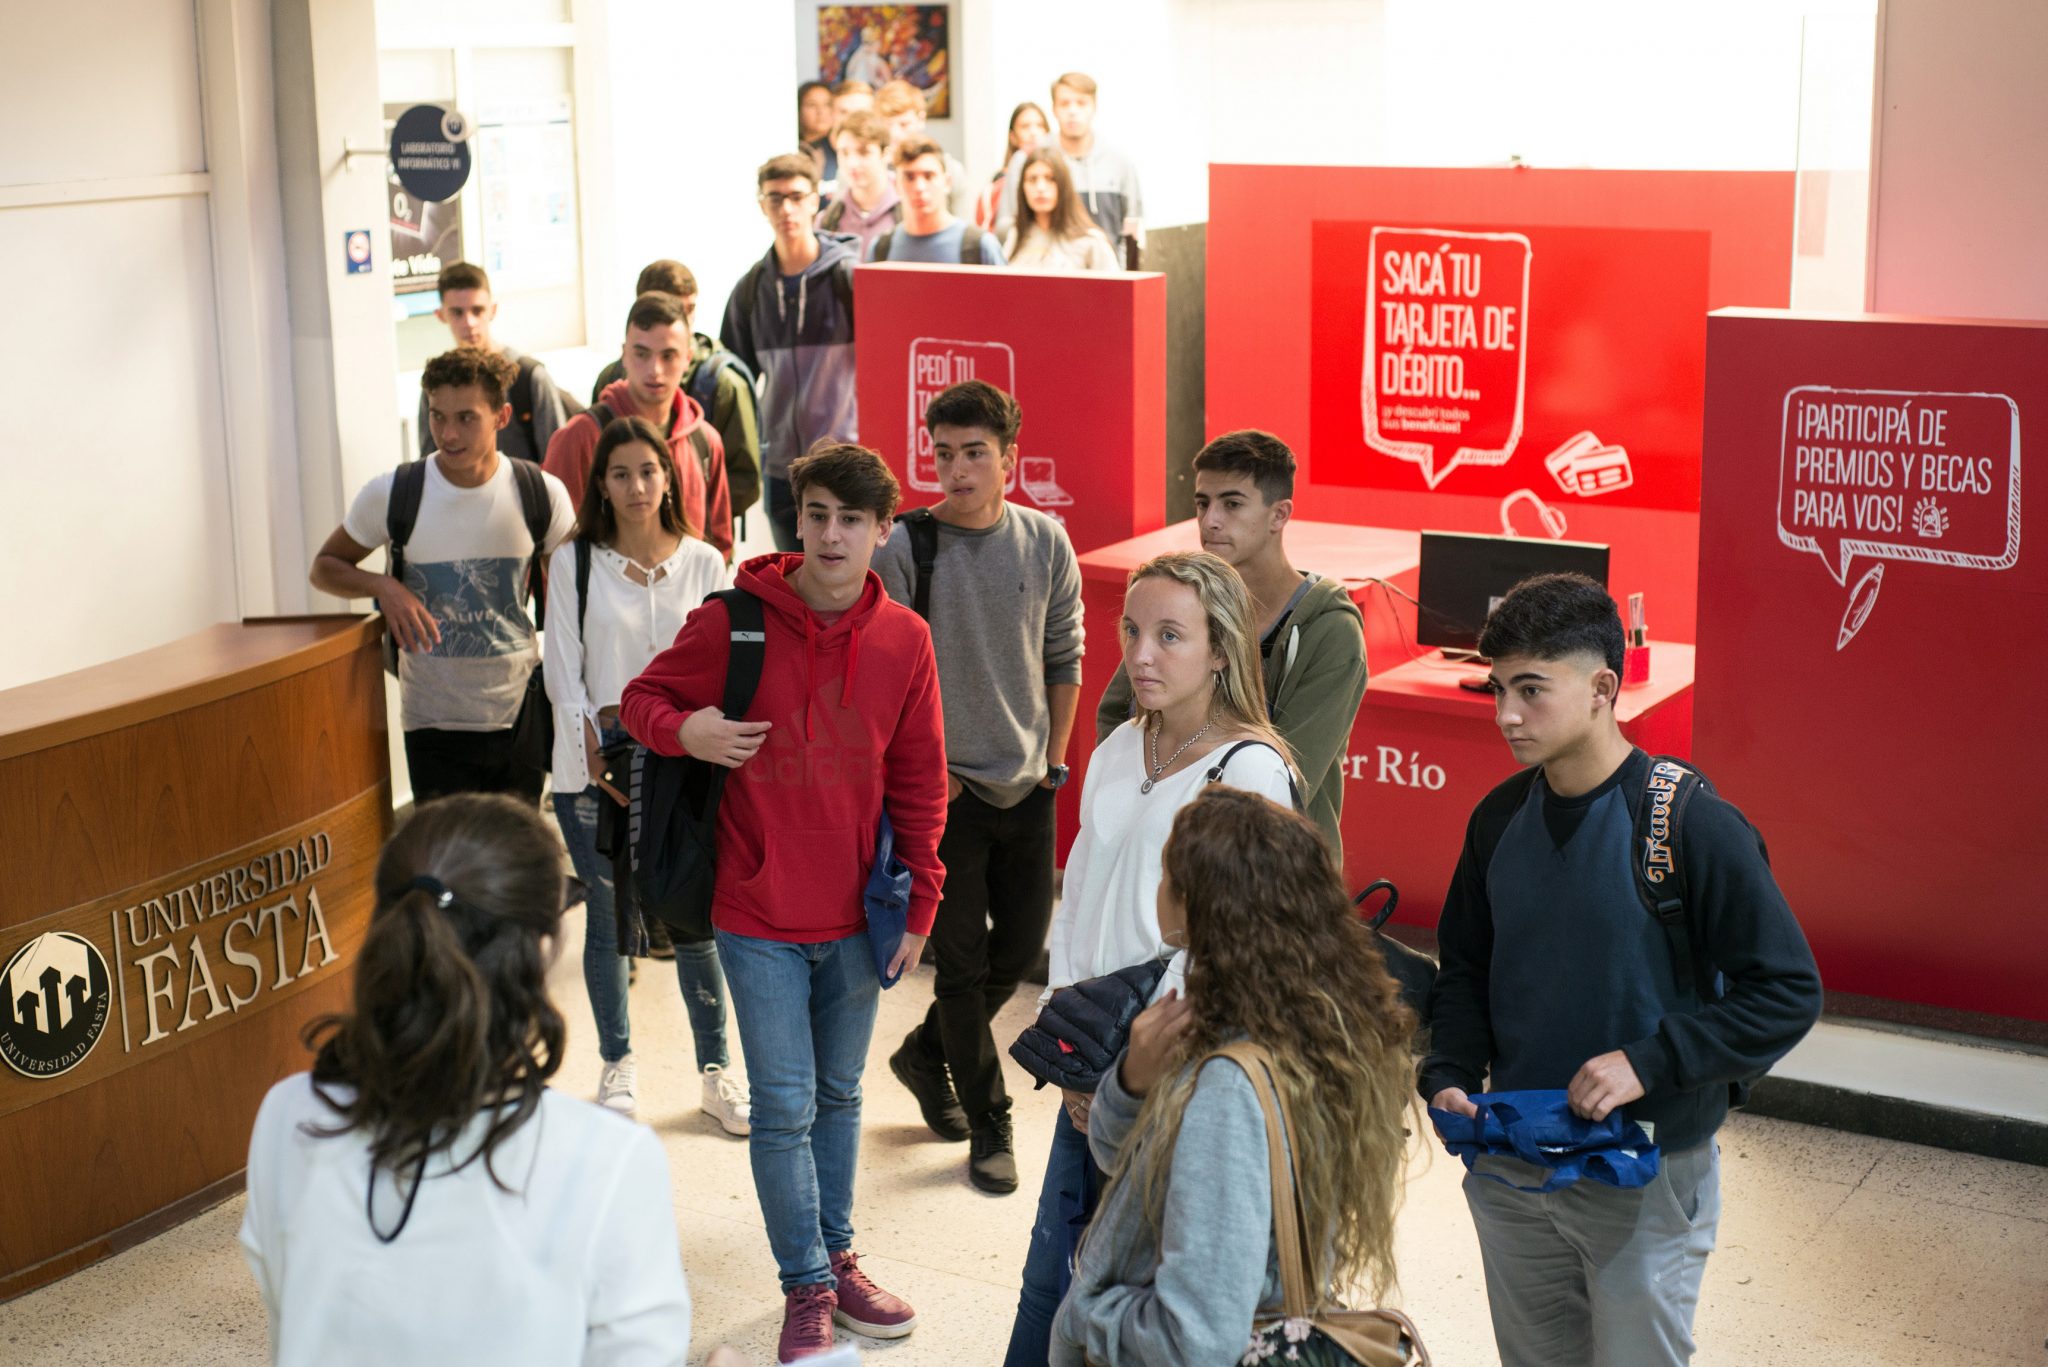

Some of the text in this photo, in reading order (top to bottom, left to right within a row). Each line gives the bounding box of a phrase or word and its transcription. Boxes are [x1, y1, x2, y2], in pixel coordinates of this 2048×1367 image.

[1382, 242, 1481, 298] SACÁ TU
[1381, 301, 1516, 350] TARJETA DE
[917, 349, 953, 387] PEDÍ
[1381, 345, 1480, 400] DÉBITO...
[1797, 400, 1947, 446] ¡PARTICIPÁ DE
[1795, 446, 1992, 494] PREMIOS Y BECAS
[1794, 489, 1903, 533] PARA VOS!
[744, 746, 880, 787] adida
[1376, 745, 1446, 791] Río
[124, 831, 332, 947] UNIVERSIDAD
[134, 885, 340, 1046] FASTA
[1, 992, 107, 1071] UNIVERSIDAD FASTA
